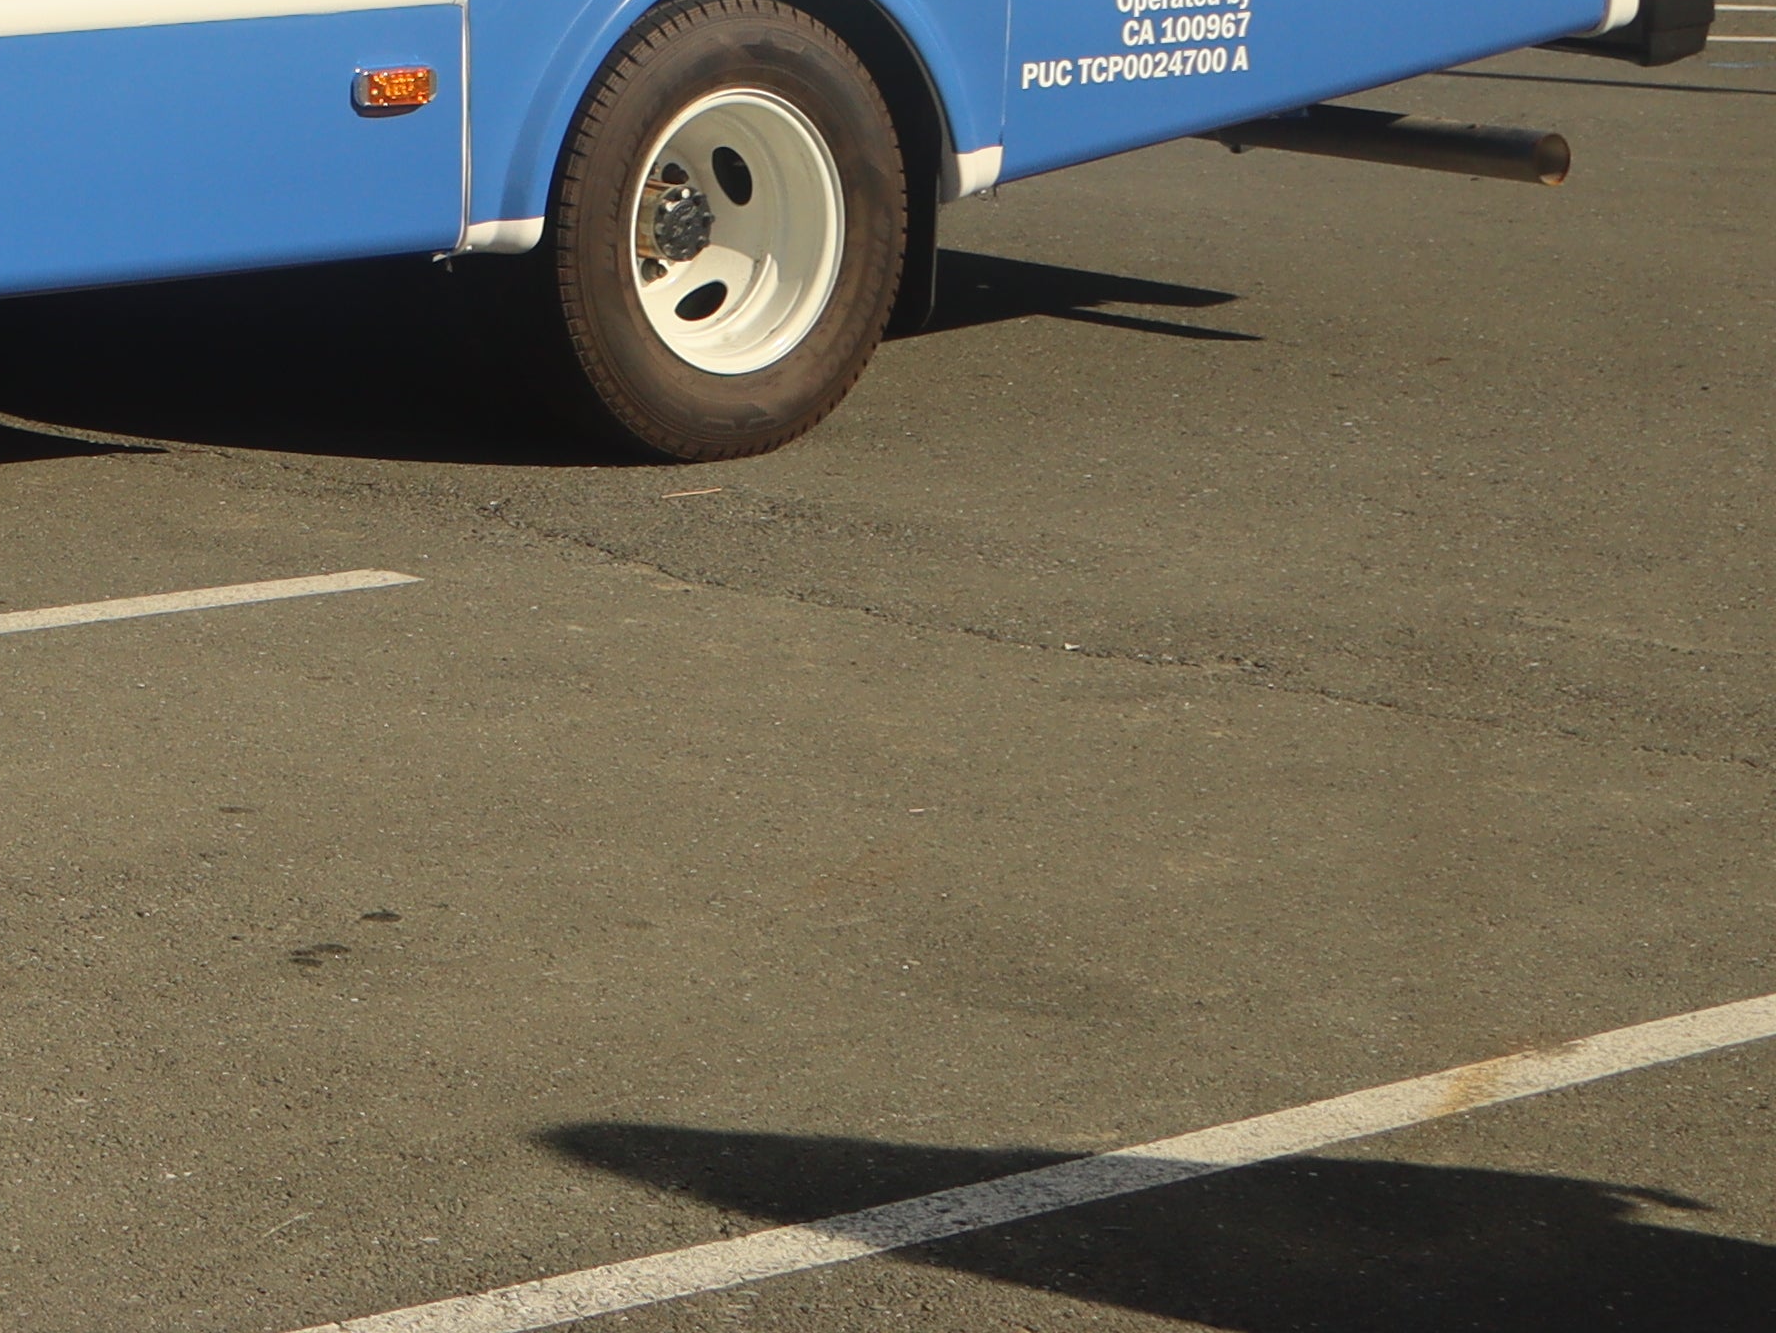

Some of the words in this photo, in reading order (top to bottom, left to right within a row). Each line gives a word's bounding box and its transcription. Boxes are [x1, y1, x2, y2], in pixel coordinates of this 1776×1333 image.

[1122, 20, 1156, 47] CA
[1160, 11, 1252, 43] 100967
[1021, 59, 1073, 90] PUC
[1077, 47, 1228, 85] TCP0024700
[1231, 45, 1250, 72] A
